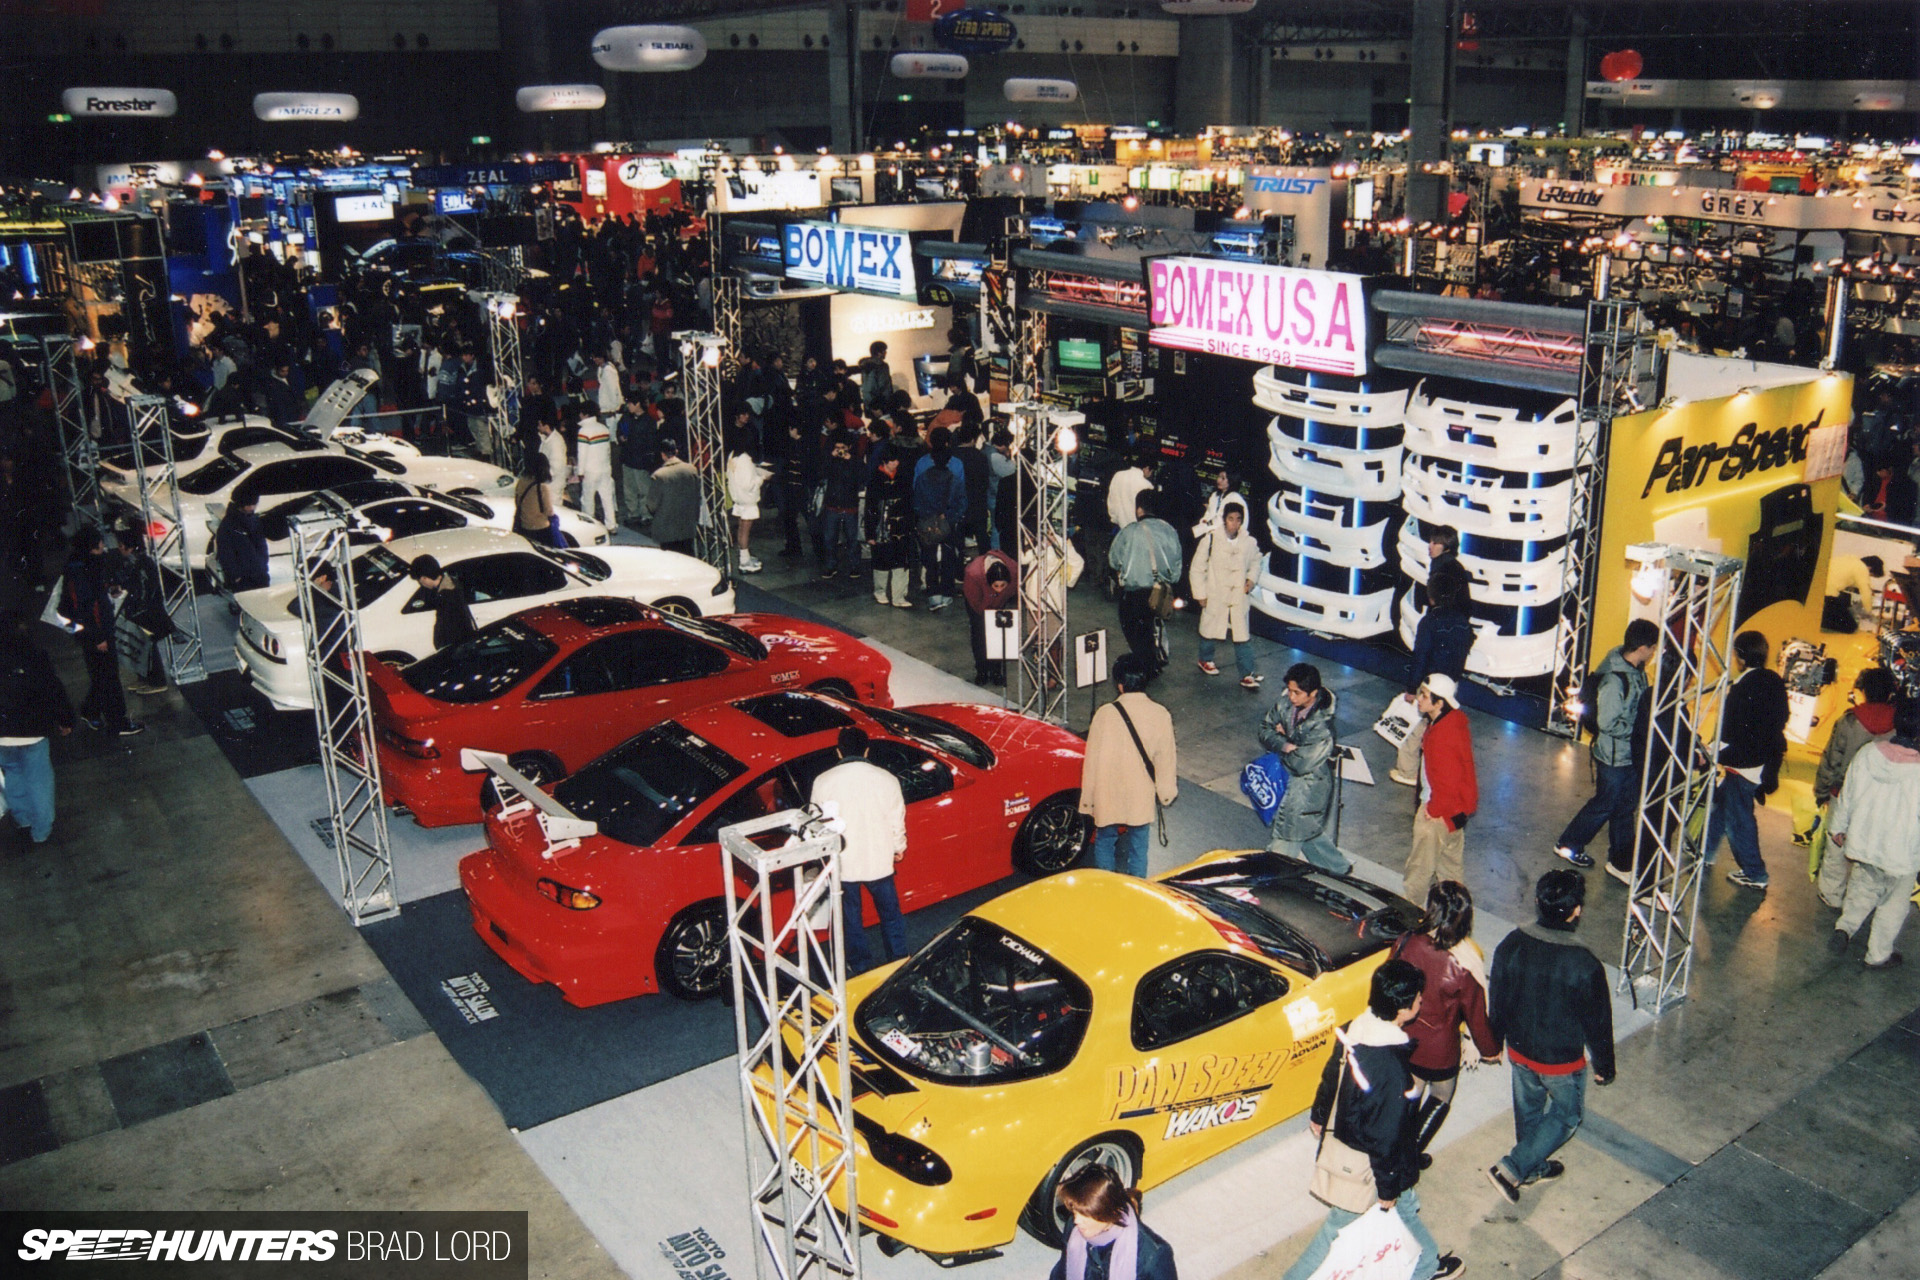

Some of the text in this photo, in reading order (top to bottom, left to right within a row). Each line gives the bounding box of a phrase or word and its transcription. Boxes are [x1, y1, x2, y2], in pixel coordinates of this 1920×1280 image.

[931, 0, 943, 19] 2
[651, 41, 694, 50] SUBARU
[86, 97, 157, 113] Forester
[467, 169, 509, 184] ZEAL
[1250, 175, 1325, 195] TRUST
[1537, 185, 1604, 207] GReddy
[1701, 197, 1765, 218] GREX
[785, 223, 901, 288] BOMEX
[1151, 262, 1254, 337] BOMEX
[1207, 337, 1292, 367] SINCE 1998
[999, 935, 1045, 966] YOKOHAMA
[1290, 1038, 1319, 1061] ADVAN
[1098, 1048, 1291, 1122] PAN SPEED
[666, 1232, 712, 1268] AUTO
[692, 1226, 726, 1260] TOKYO
